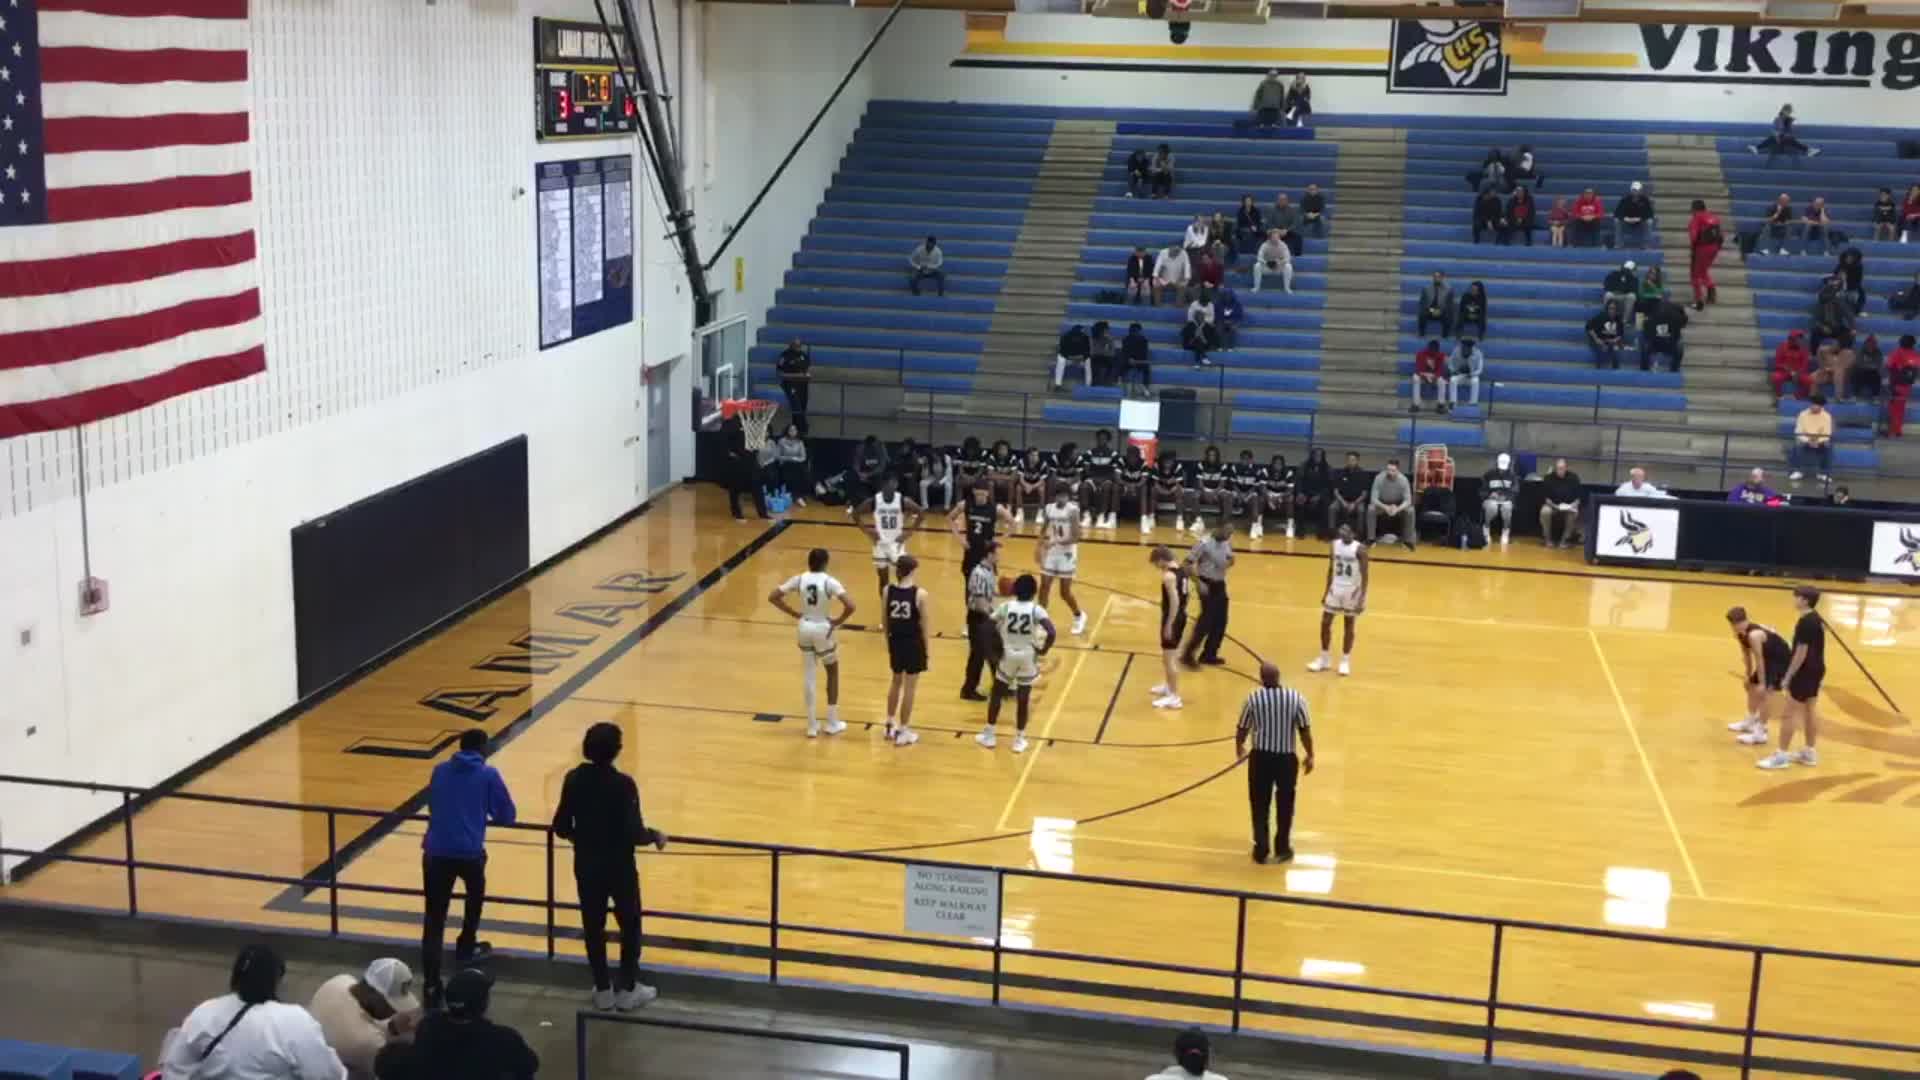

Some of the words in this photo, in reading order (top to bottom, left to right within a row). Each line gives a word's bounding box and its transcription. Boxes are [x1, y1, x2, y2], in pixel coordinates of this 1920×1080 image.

[974, 521, 983, 534] 2
[807, 584, 819, 606] 3
[890, 602, 912, 619] 23
[1007, 612, 1032, 635] 22
[343, 569, 688, 760] LAMAR
[936, 911, 966, 920] CLEAR
